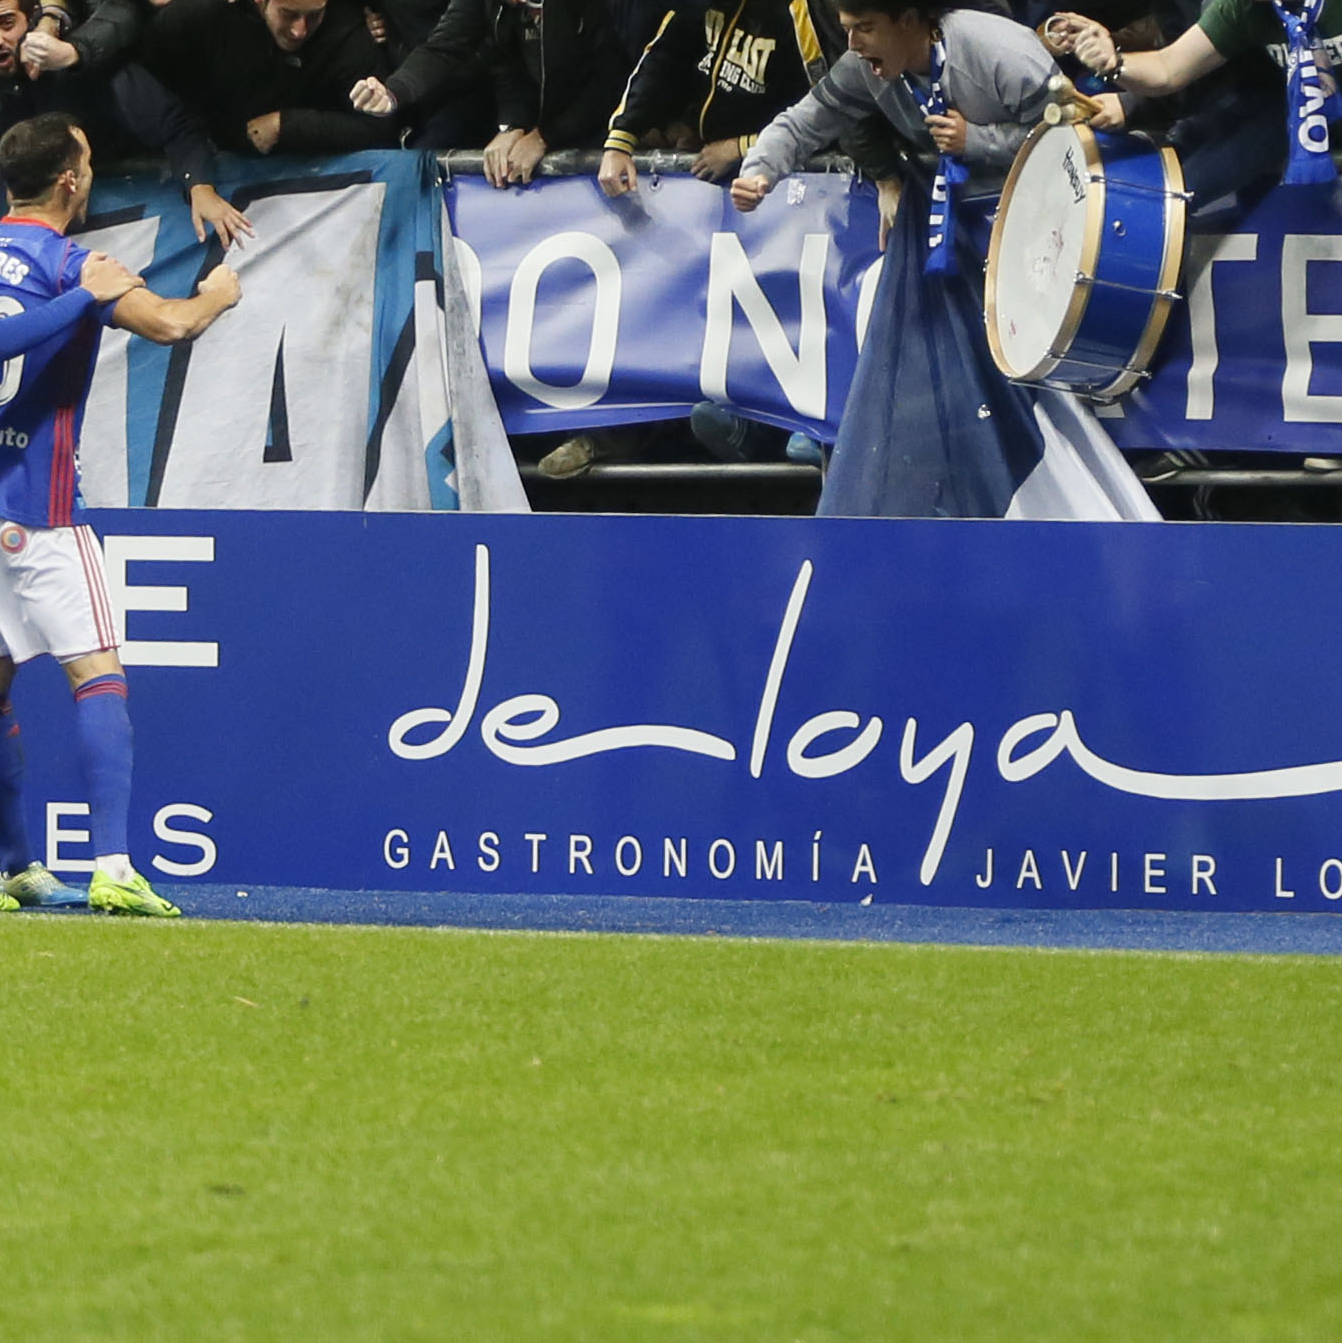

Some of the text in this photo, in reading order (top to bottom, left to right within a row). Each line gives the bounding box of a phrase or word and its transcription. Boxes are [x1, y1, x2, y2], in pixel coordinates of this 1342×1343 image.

[388, 543, 736, 766] de
[383, 828, 877, 884] GASTRONOMÍA
[975, 848, 1217, 896] JAVIER
